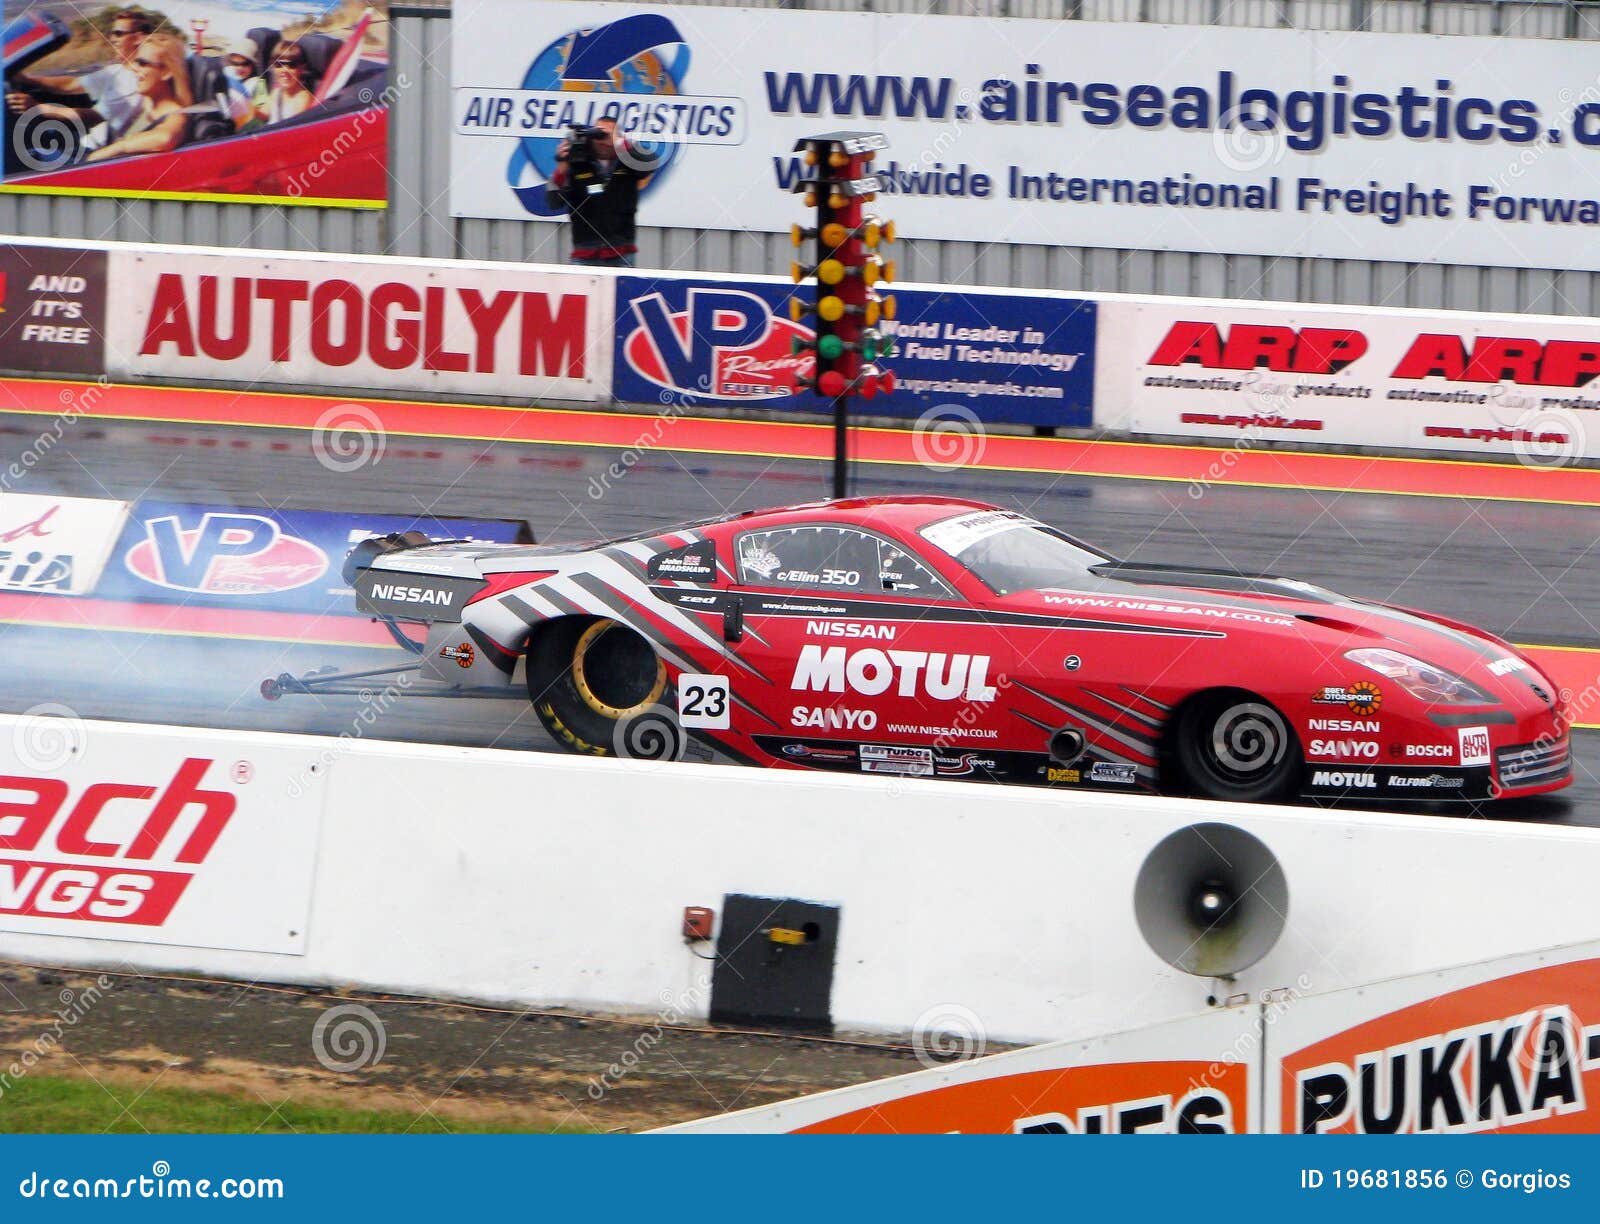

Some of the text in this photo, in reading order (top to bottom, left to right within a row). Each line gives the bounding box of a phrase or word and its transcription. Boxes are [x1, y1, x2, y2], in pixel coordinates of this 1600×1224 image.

[464, 97, 513, 128] AIR
[520, 98, 575, 131] SEA
[1010, 166, 1279, 211] International
[1298, 178, 1451, 226] Freight
[1469, 185, 1600, 224] Forwa
[28, 274, 87, 294] AND
[31, 300, 83, 319] IT'S
[21, 325, 91, 344] FREE
[139, 273, 588, 379] AUTOGLYM
[880, 320, 1045, 345] World Leader in
[630, 287, 773, 396] VP
[1146, 320, 1369, 375] ARP
[905, 343, 952, 361] Fuel
[1389, 333, 1600, 387] ARP
[722, 353, 817, 384] Racing
[722, 384, 790, 397] FUELS
[1144, 376, 1243, 392] automotive
[1293, 384, 1373, 400] products
[1387, 388, 1487, 405] automotive
[144, 512, 281, 593] VP
[820, 569, 860, 586] 350
[879, 571, 903, 580] OPEN
[371, 583, 453, 605] NISSAN
[1043, 595, 1296, 627] WWW.NISSAN.CO.UK
[806, 620, 896, 640] NISSAN
[790, 644, 998, 703] MOTUL
[682, 685, 727, 718] 23
[790, 706, 878, 731] SANYO
[1308, 718, 1380, 733] NISSAN
[887, 723, 998, 738] WWW.NISSAN.CO.UK
[1462, 733, 1487, 747] AUTO
[1308, 739, 1380, 758] SANYO
[1405, 745, 1453, 757] BOSCH
[1463, 745, 1489, 759] GLYM
[1311, 771, 1377, 788] MOTUL
